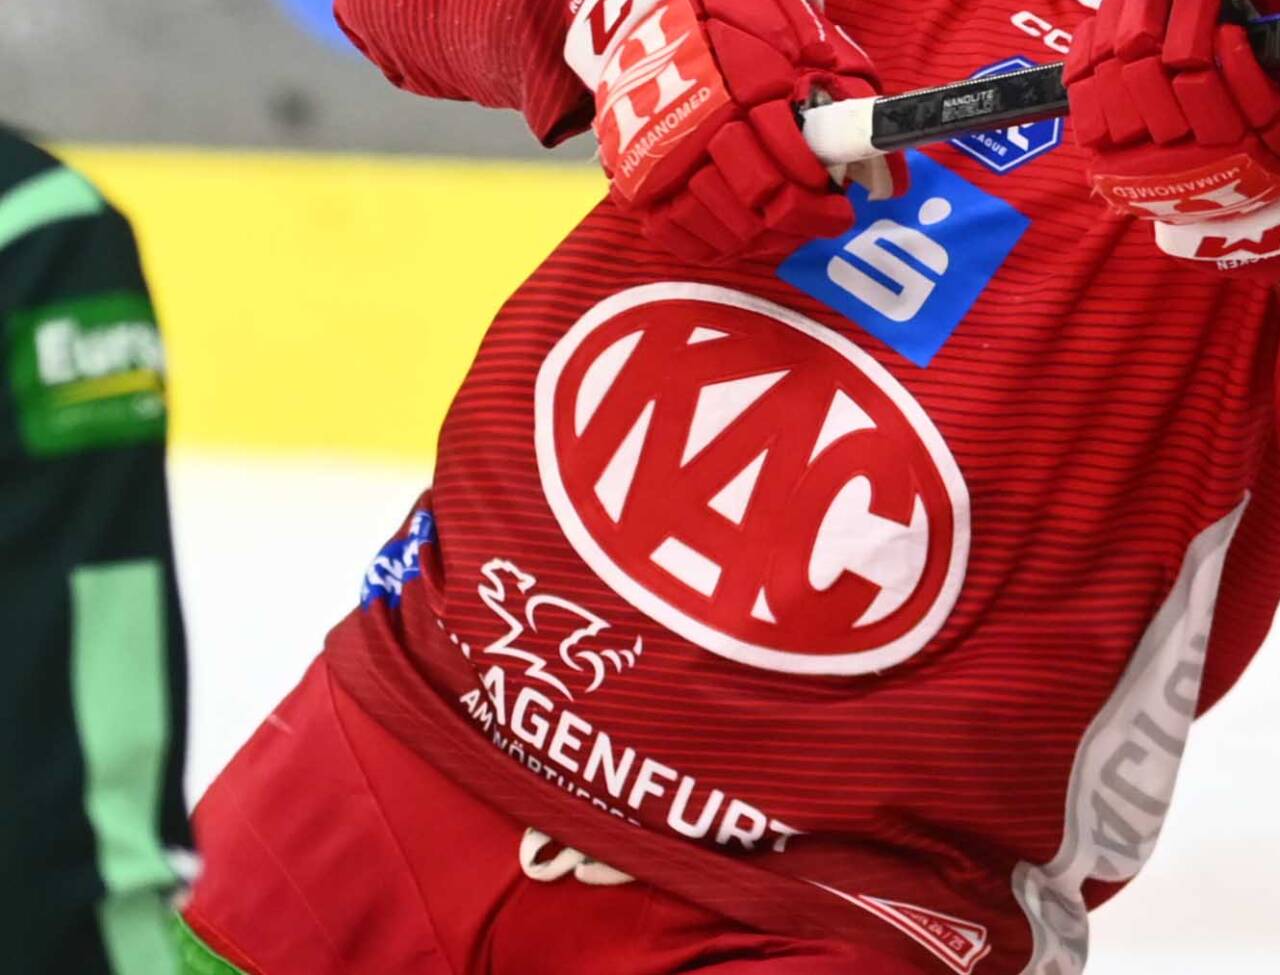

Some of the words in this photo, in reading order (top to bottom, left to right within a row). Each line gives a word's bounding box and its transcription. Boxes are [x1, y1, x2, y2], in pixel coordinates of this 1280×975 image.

[1010, 10, 1073, 54] CC
[619, 86, 712, 177] HUMANOMED
[971, 133, 1008, 157] AGUE
[459, 687, 495, 731] AM
[479, 664, 806, 853] AGENFURT
